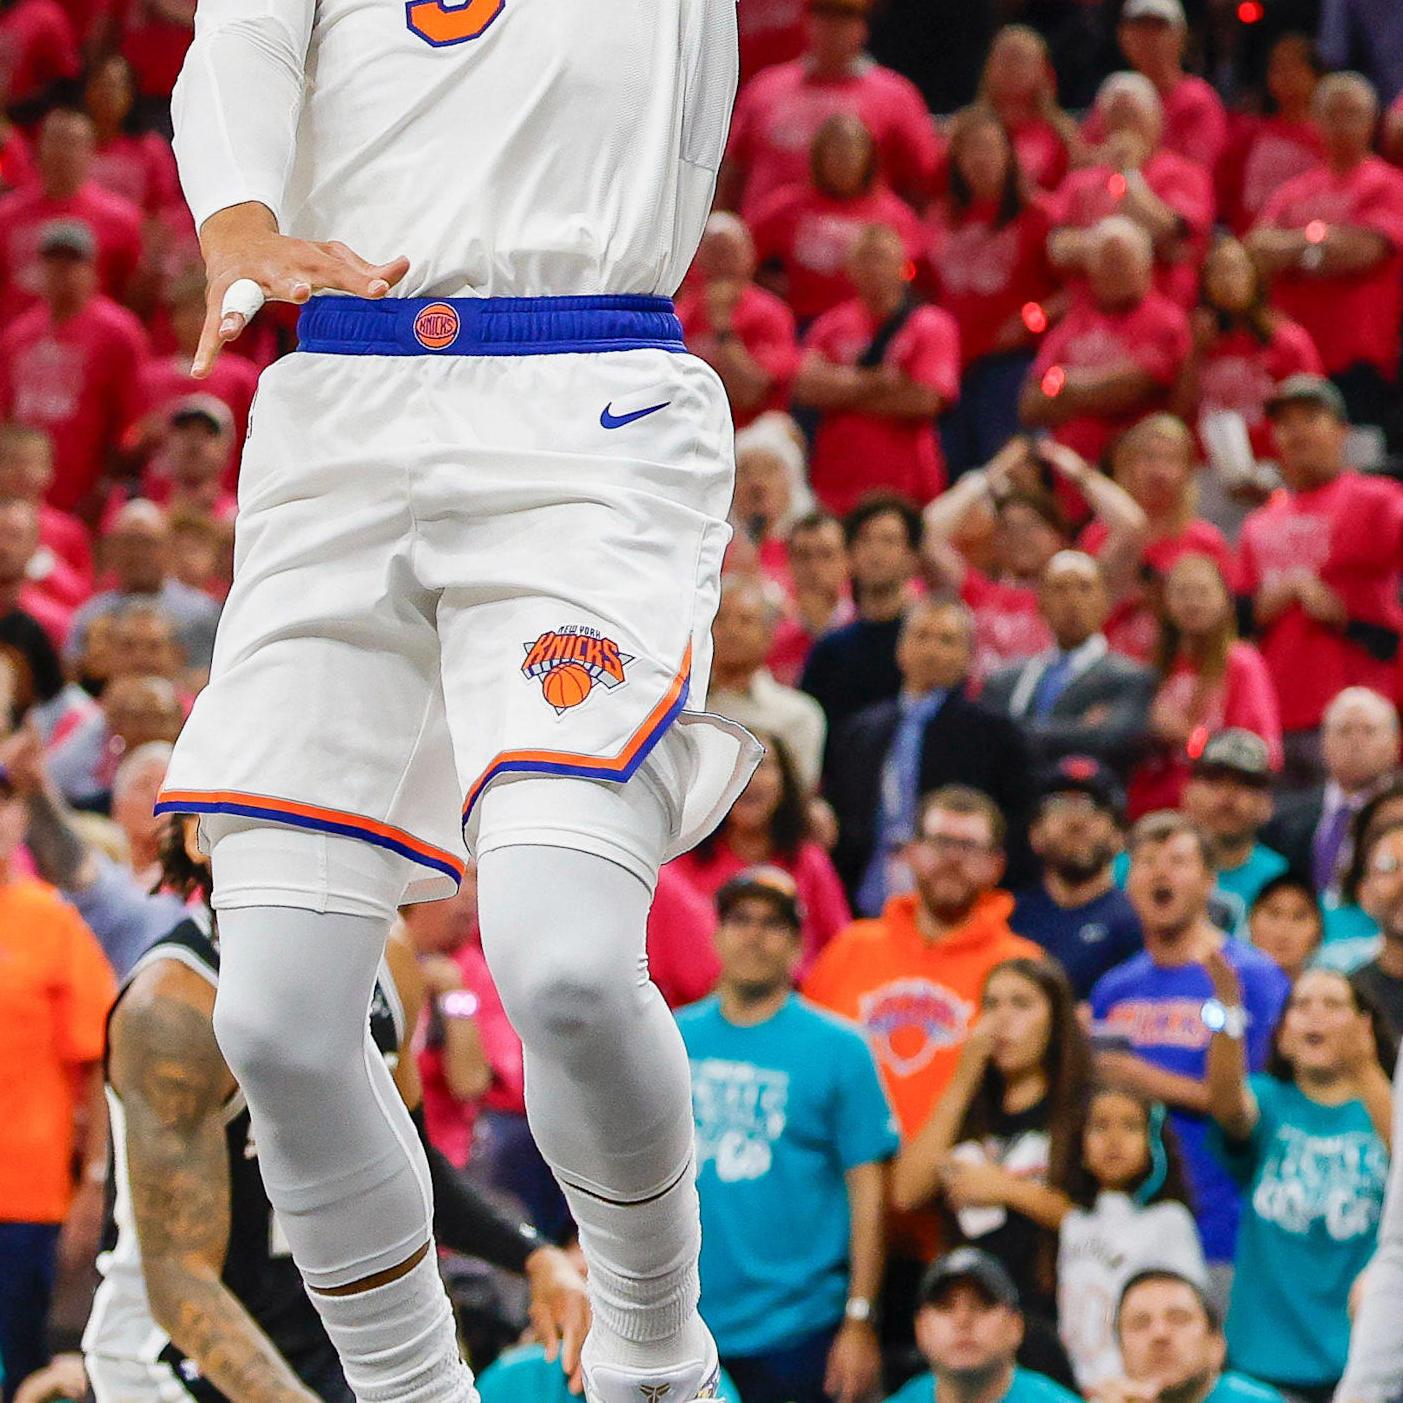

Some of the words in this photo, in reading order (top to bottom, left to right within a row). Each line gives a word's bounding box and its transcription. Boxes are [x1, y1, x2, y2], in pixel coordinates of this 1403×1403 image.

[419, 315, 454, 336] KNICKS
[557, 625, 577, 635] NEW
[579, 625, 601, 639] YORK
[521, 631, 625, 682] KNICKS
